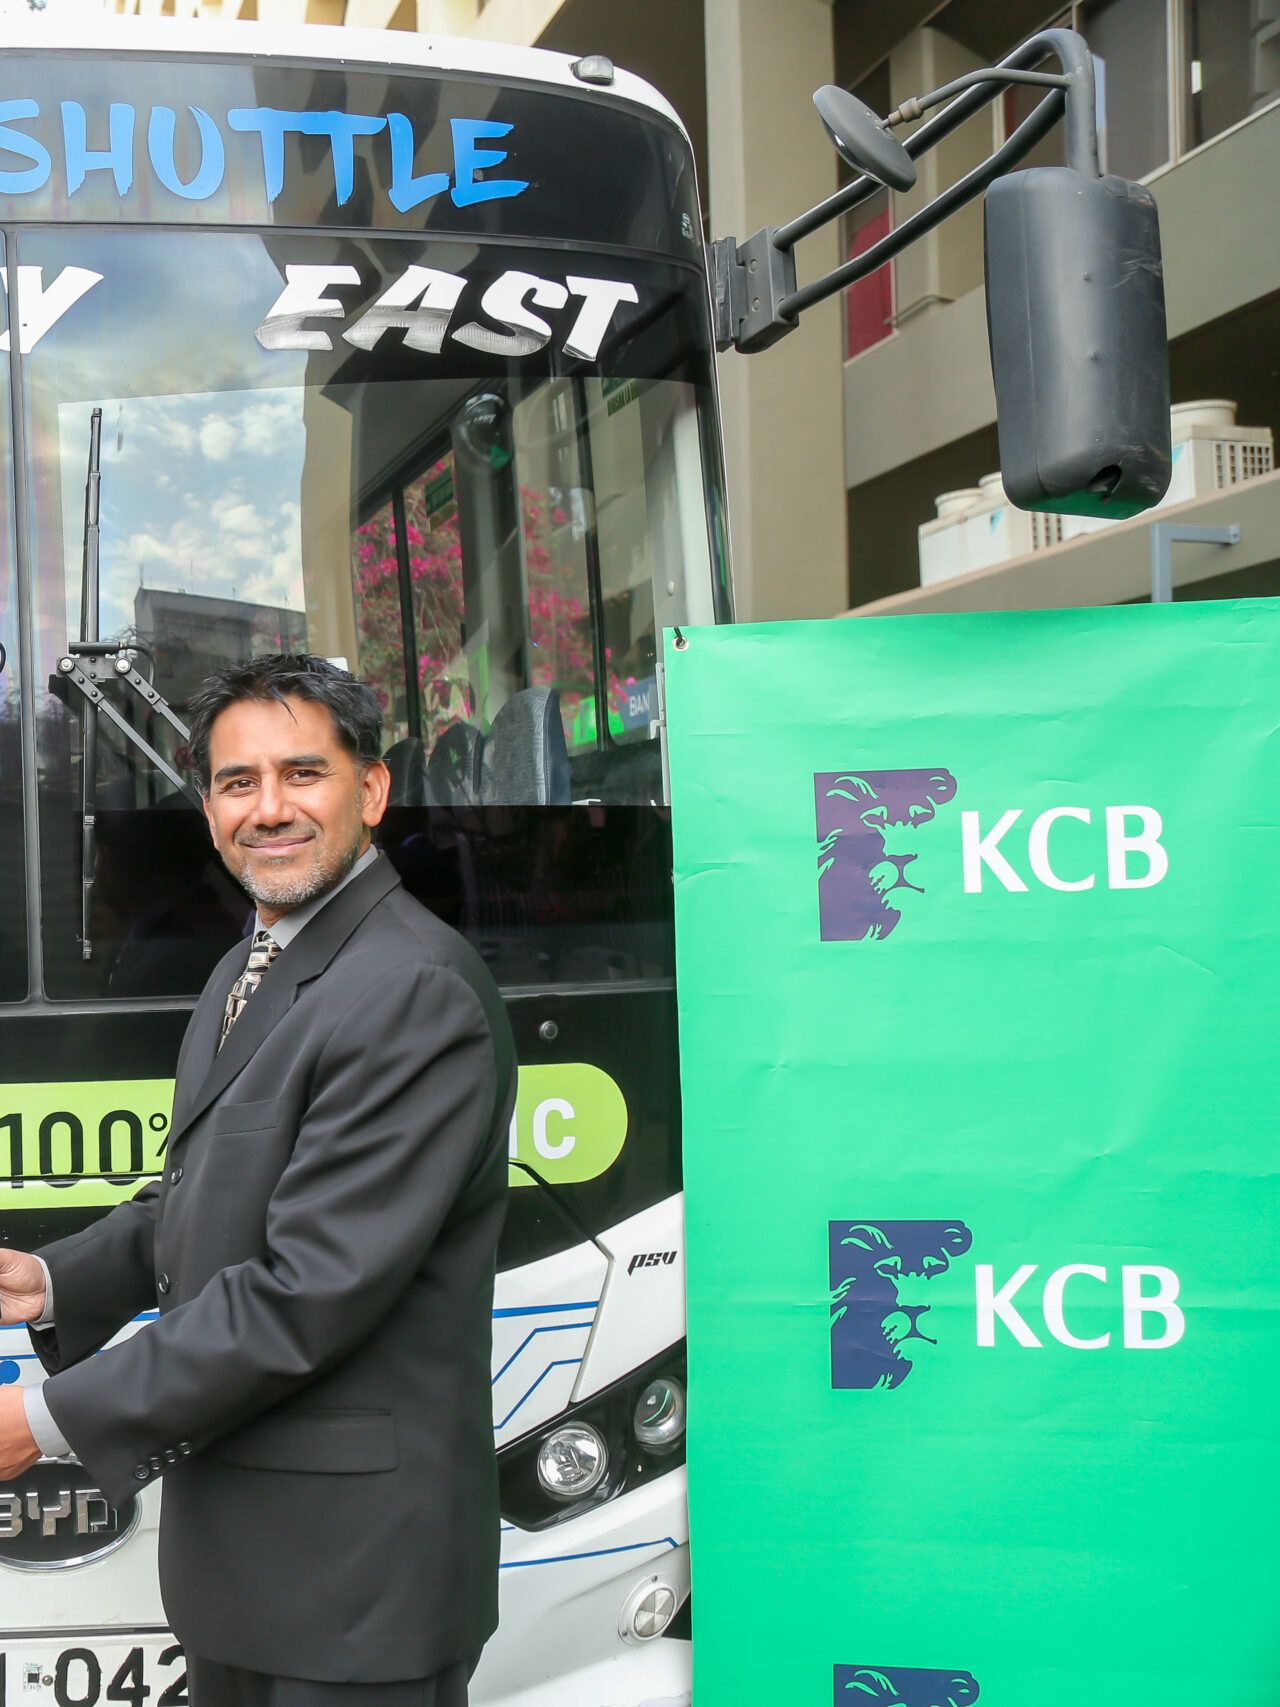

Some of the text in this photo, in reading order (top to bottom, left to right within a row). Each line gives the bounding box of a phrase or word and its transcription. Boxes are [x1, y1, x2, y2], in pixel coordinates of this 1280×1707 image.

[254, 264, 639, 363] EAST
[960, 805, 1169, 894] KCB
[974, 1263, 1187, 1350] KCB
